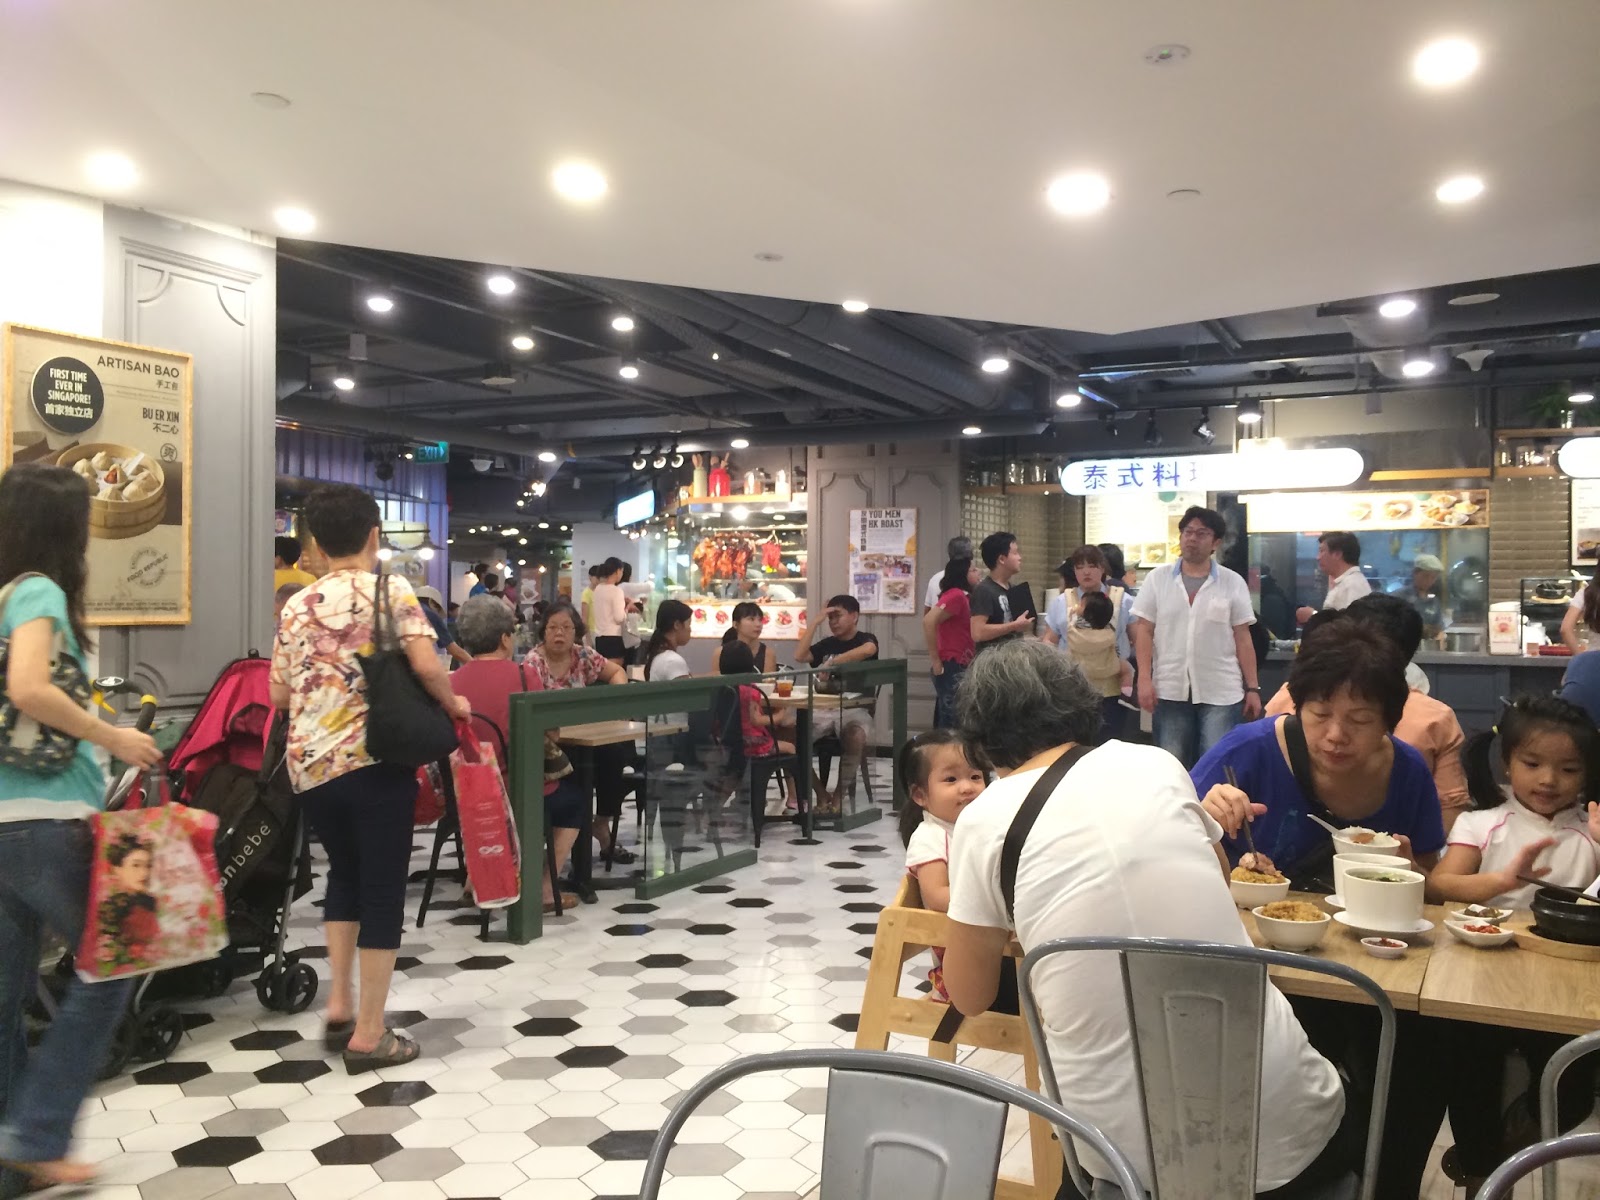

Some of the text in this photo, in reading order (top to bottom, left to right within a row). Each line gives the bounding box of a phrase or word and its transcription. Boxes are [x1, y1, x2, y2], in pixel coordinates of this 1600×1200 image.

[97, 355, 180, 378] ARTISAN BAO
[49, 368, 88, 382] FIRST TIME
[55, 379, 83, 393] EVER IN
[47, 389, 91, 404] SINGAPORE!
[142, 407, 180, 423] BU ER XIN
[152, 422, 179, 435] 不二心
[418, 445, 437, 459] EXIT
[869, 510, 901, 518] YOU MEN
[869, 519, 904, 528] HK ROAST
[127, 569, 144, 583] FOOD
[214, 825, 271, 892] onbebe
